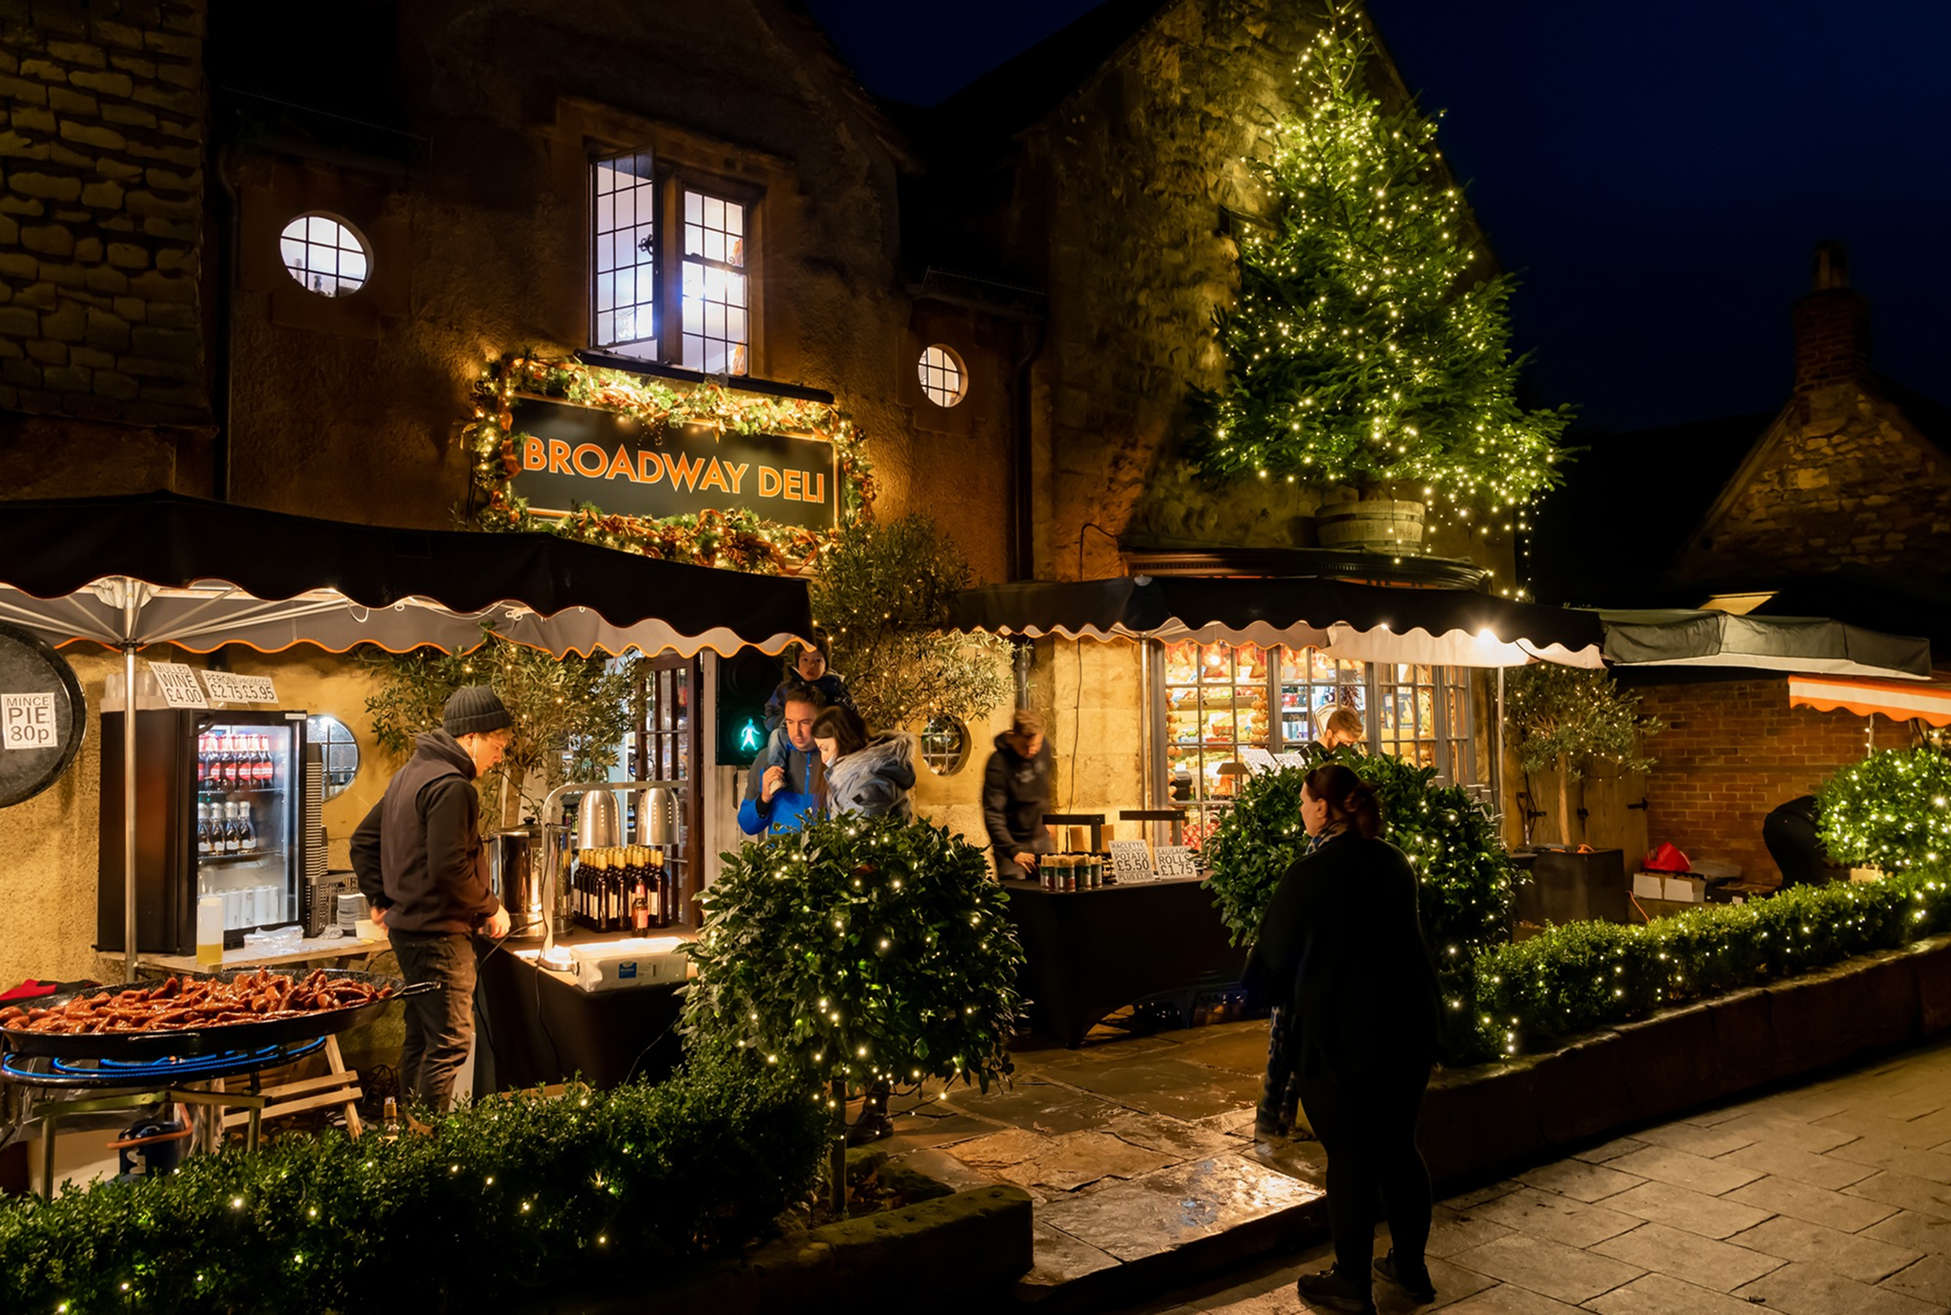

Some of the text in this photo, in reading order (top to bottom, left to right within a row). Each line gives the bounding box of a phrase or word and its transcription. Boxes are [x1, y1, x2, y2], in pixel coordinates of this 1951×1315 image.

[522, 436, 825, 505] BROADWAY DELI
[158, 673, 197, 689] WINE
[166, 688, 203, 704] £4.00
[210, 683, 243, 700] £2.75
[242, 685, 275, 700] £5.95
[6, 697, 49, 706] MINCE
[8, 707, 50, 725] PIE
[10, 725, 49, 743] 80p
[1114, 852, 1149, 860] POTATO
[1158, 855, 1191, 865] ROLLS
[1116, 859, 1150, 872] £5.50
[1160, 863, 1193, 876] £1.75
